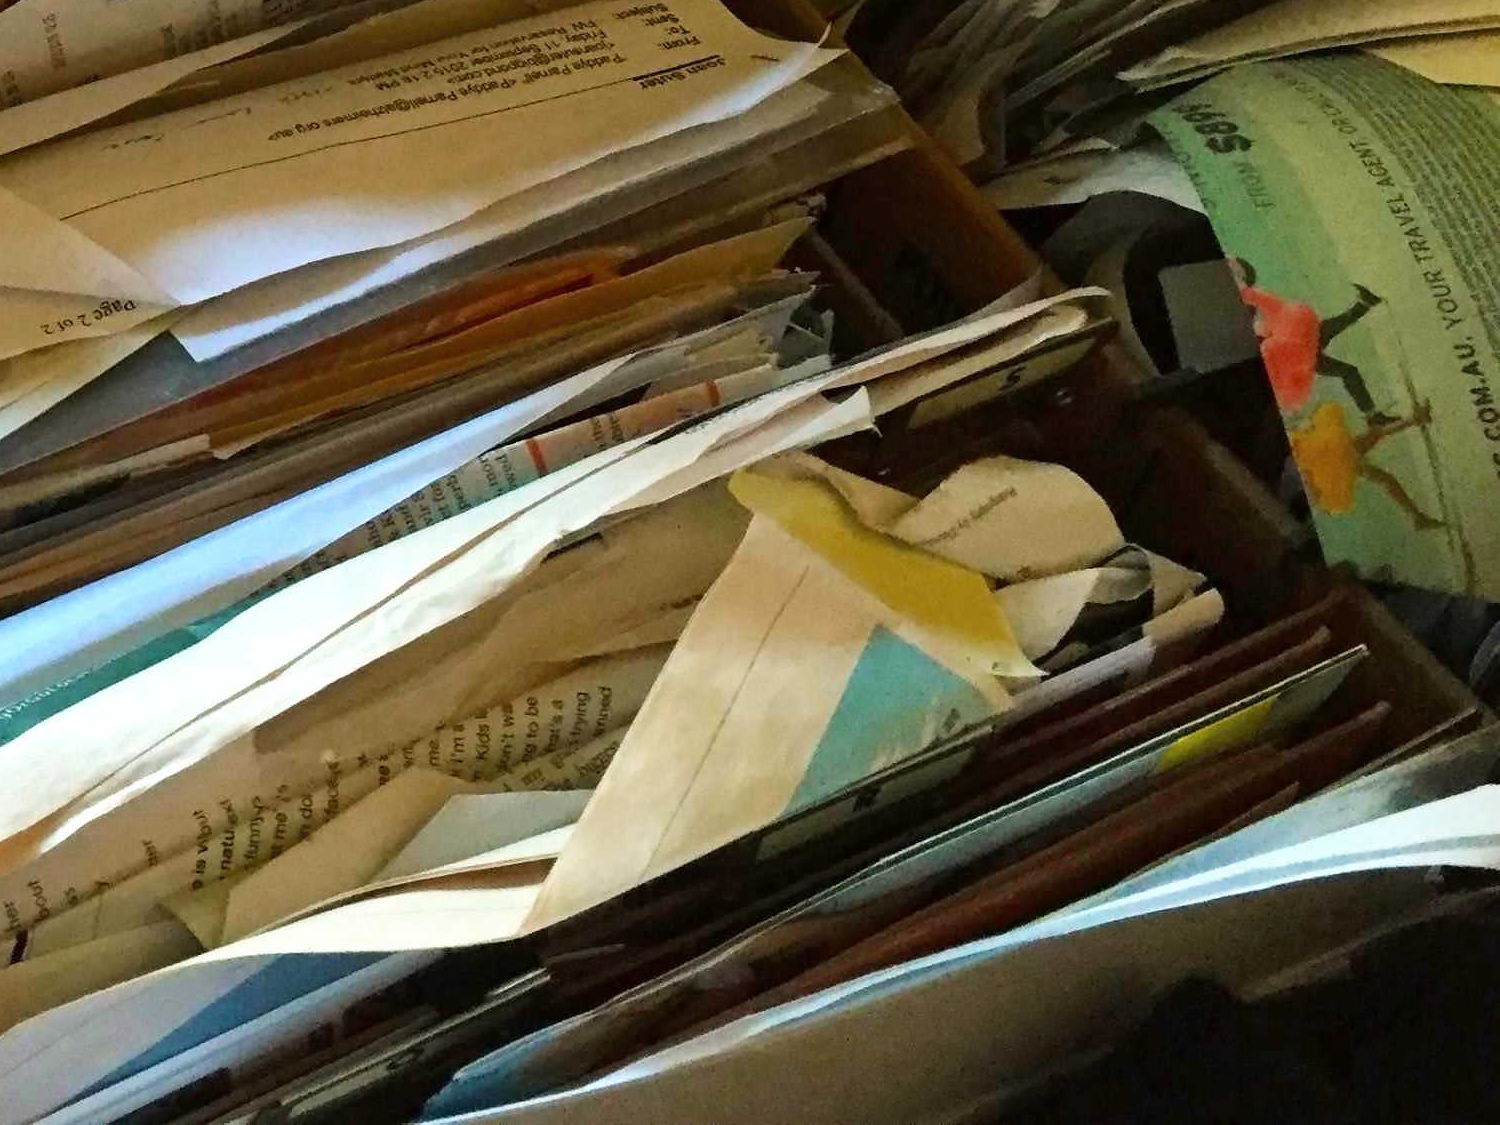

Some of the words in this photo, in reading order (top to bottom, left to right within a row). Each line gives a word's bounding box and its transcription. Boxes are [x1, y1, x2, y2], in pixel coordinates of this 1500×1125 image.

[659, 37, 702, 50] From:
[1387, 192, 1431, 265] TRAVEL
[1422, 270, 1462, 330] YOUR
[77, 314, 92, 327] 2
[92, 300, 137, 321] Page
[40, 324, 54, 335] 2
[57, 318, 74, 331] of
[525, 696, 539, 716] be
[475, 725, 491, 762] Kids
